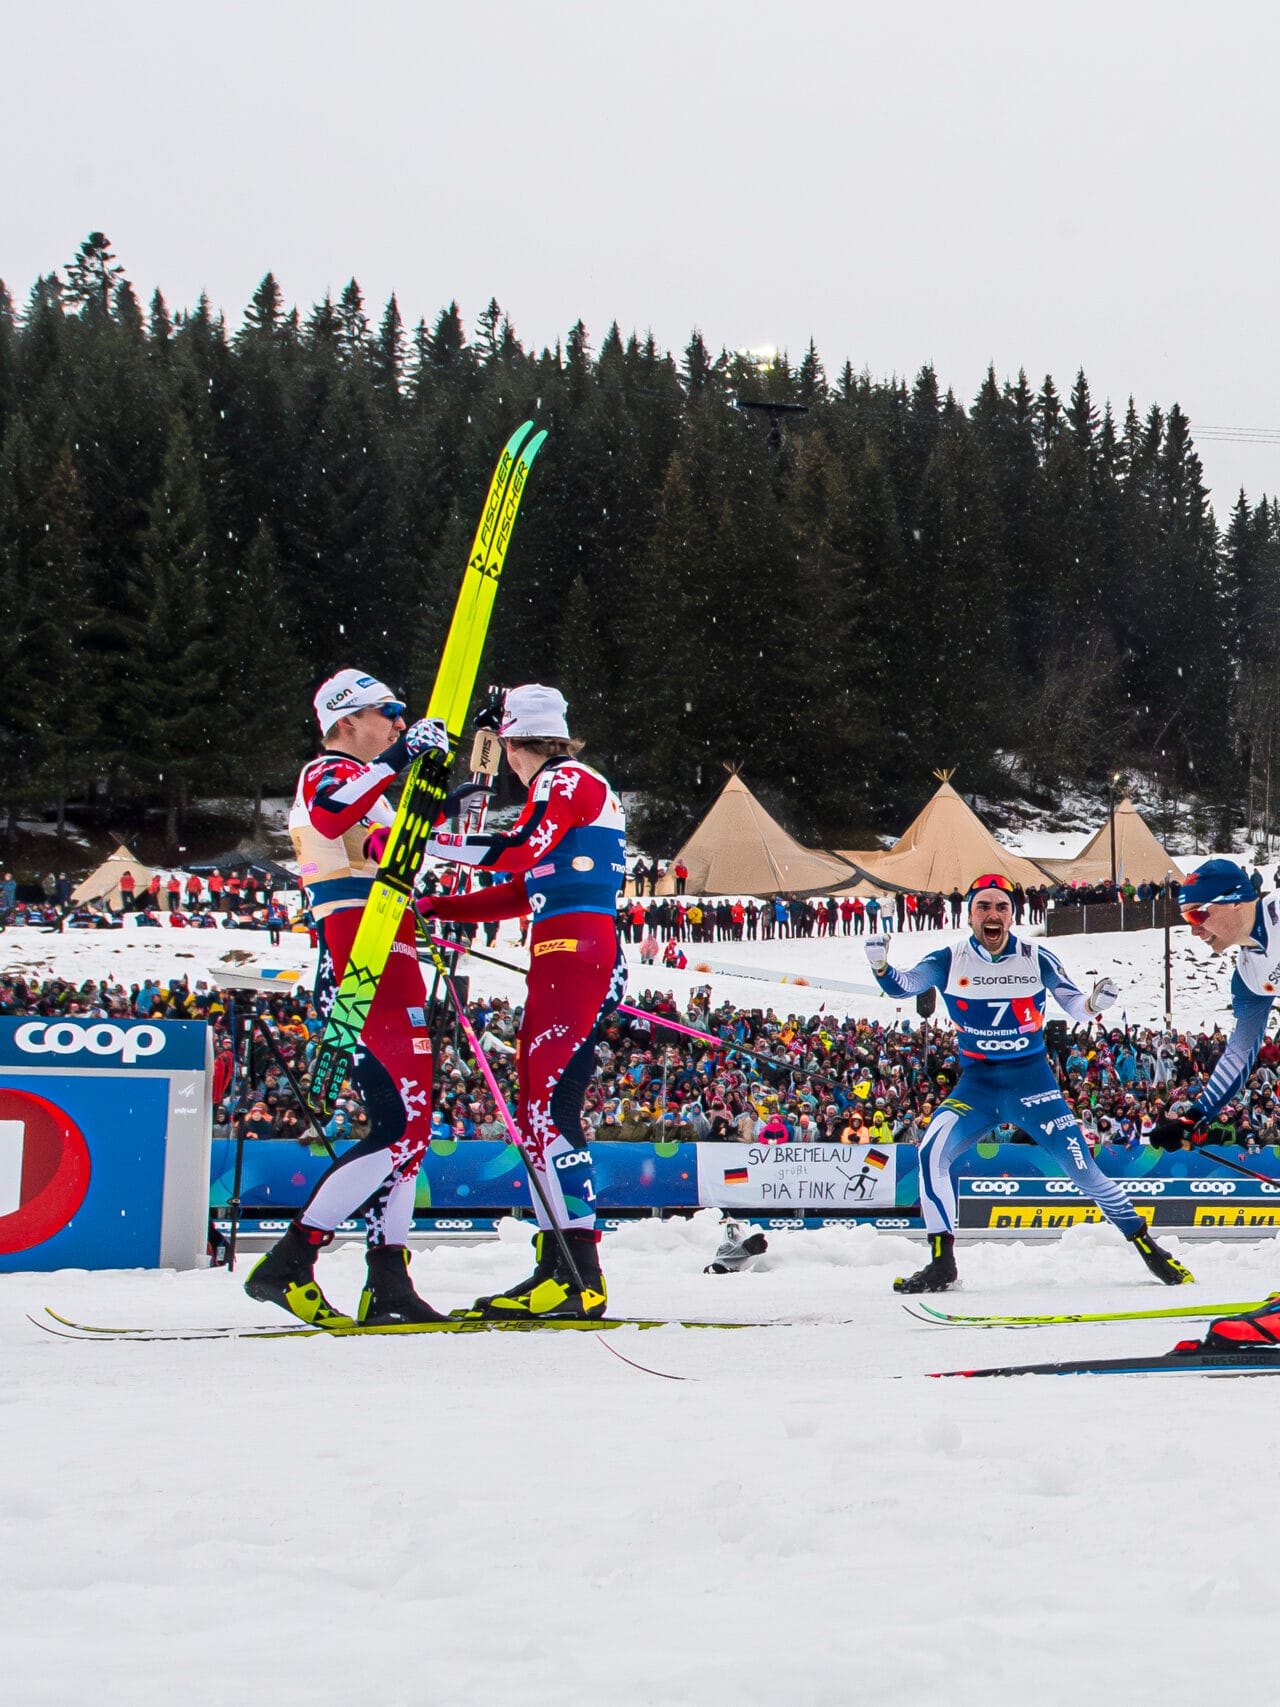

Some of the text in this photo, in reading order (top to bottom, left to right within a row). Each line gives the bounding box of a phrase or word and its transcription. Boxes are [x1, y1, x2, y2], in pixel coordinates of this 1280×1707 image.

[481, 451, 512, 547] FISCHER
[497, 460, 528, 556] FISCHER
[973, 975, 1037, 985] StoraEnso
[987, 1002, 1010, 1027] 7
[1024, 1008, 1032, 1021] 1
[964, 1026, 1018, 1036] TRONDHEIM
[15, 1022, 166, 1063] coop
[976, 1037, 1029, 1051] coop
[748, 1147, 853, 1166] SV BREMELAU
[583, 1179, 596, 1201] 1
[761, 1181, 836, 1200] PIA FINK
[971, 1181, 1020, 1195] coop
[1190, 1181, 1236, 1195] coop
[435, 1219, 473, 1231] coop
[876, 1219, 910, 1230] coop
